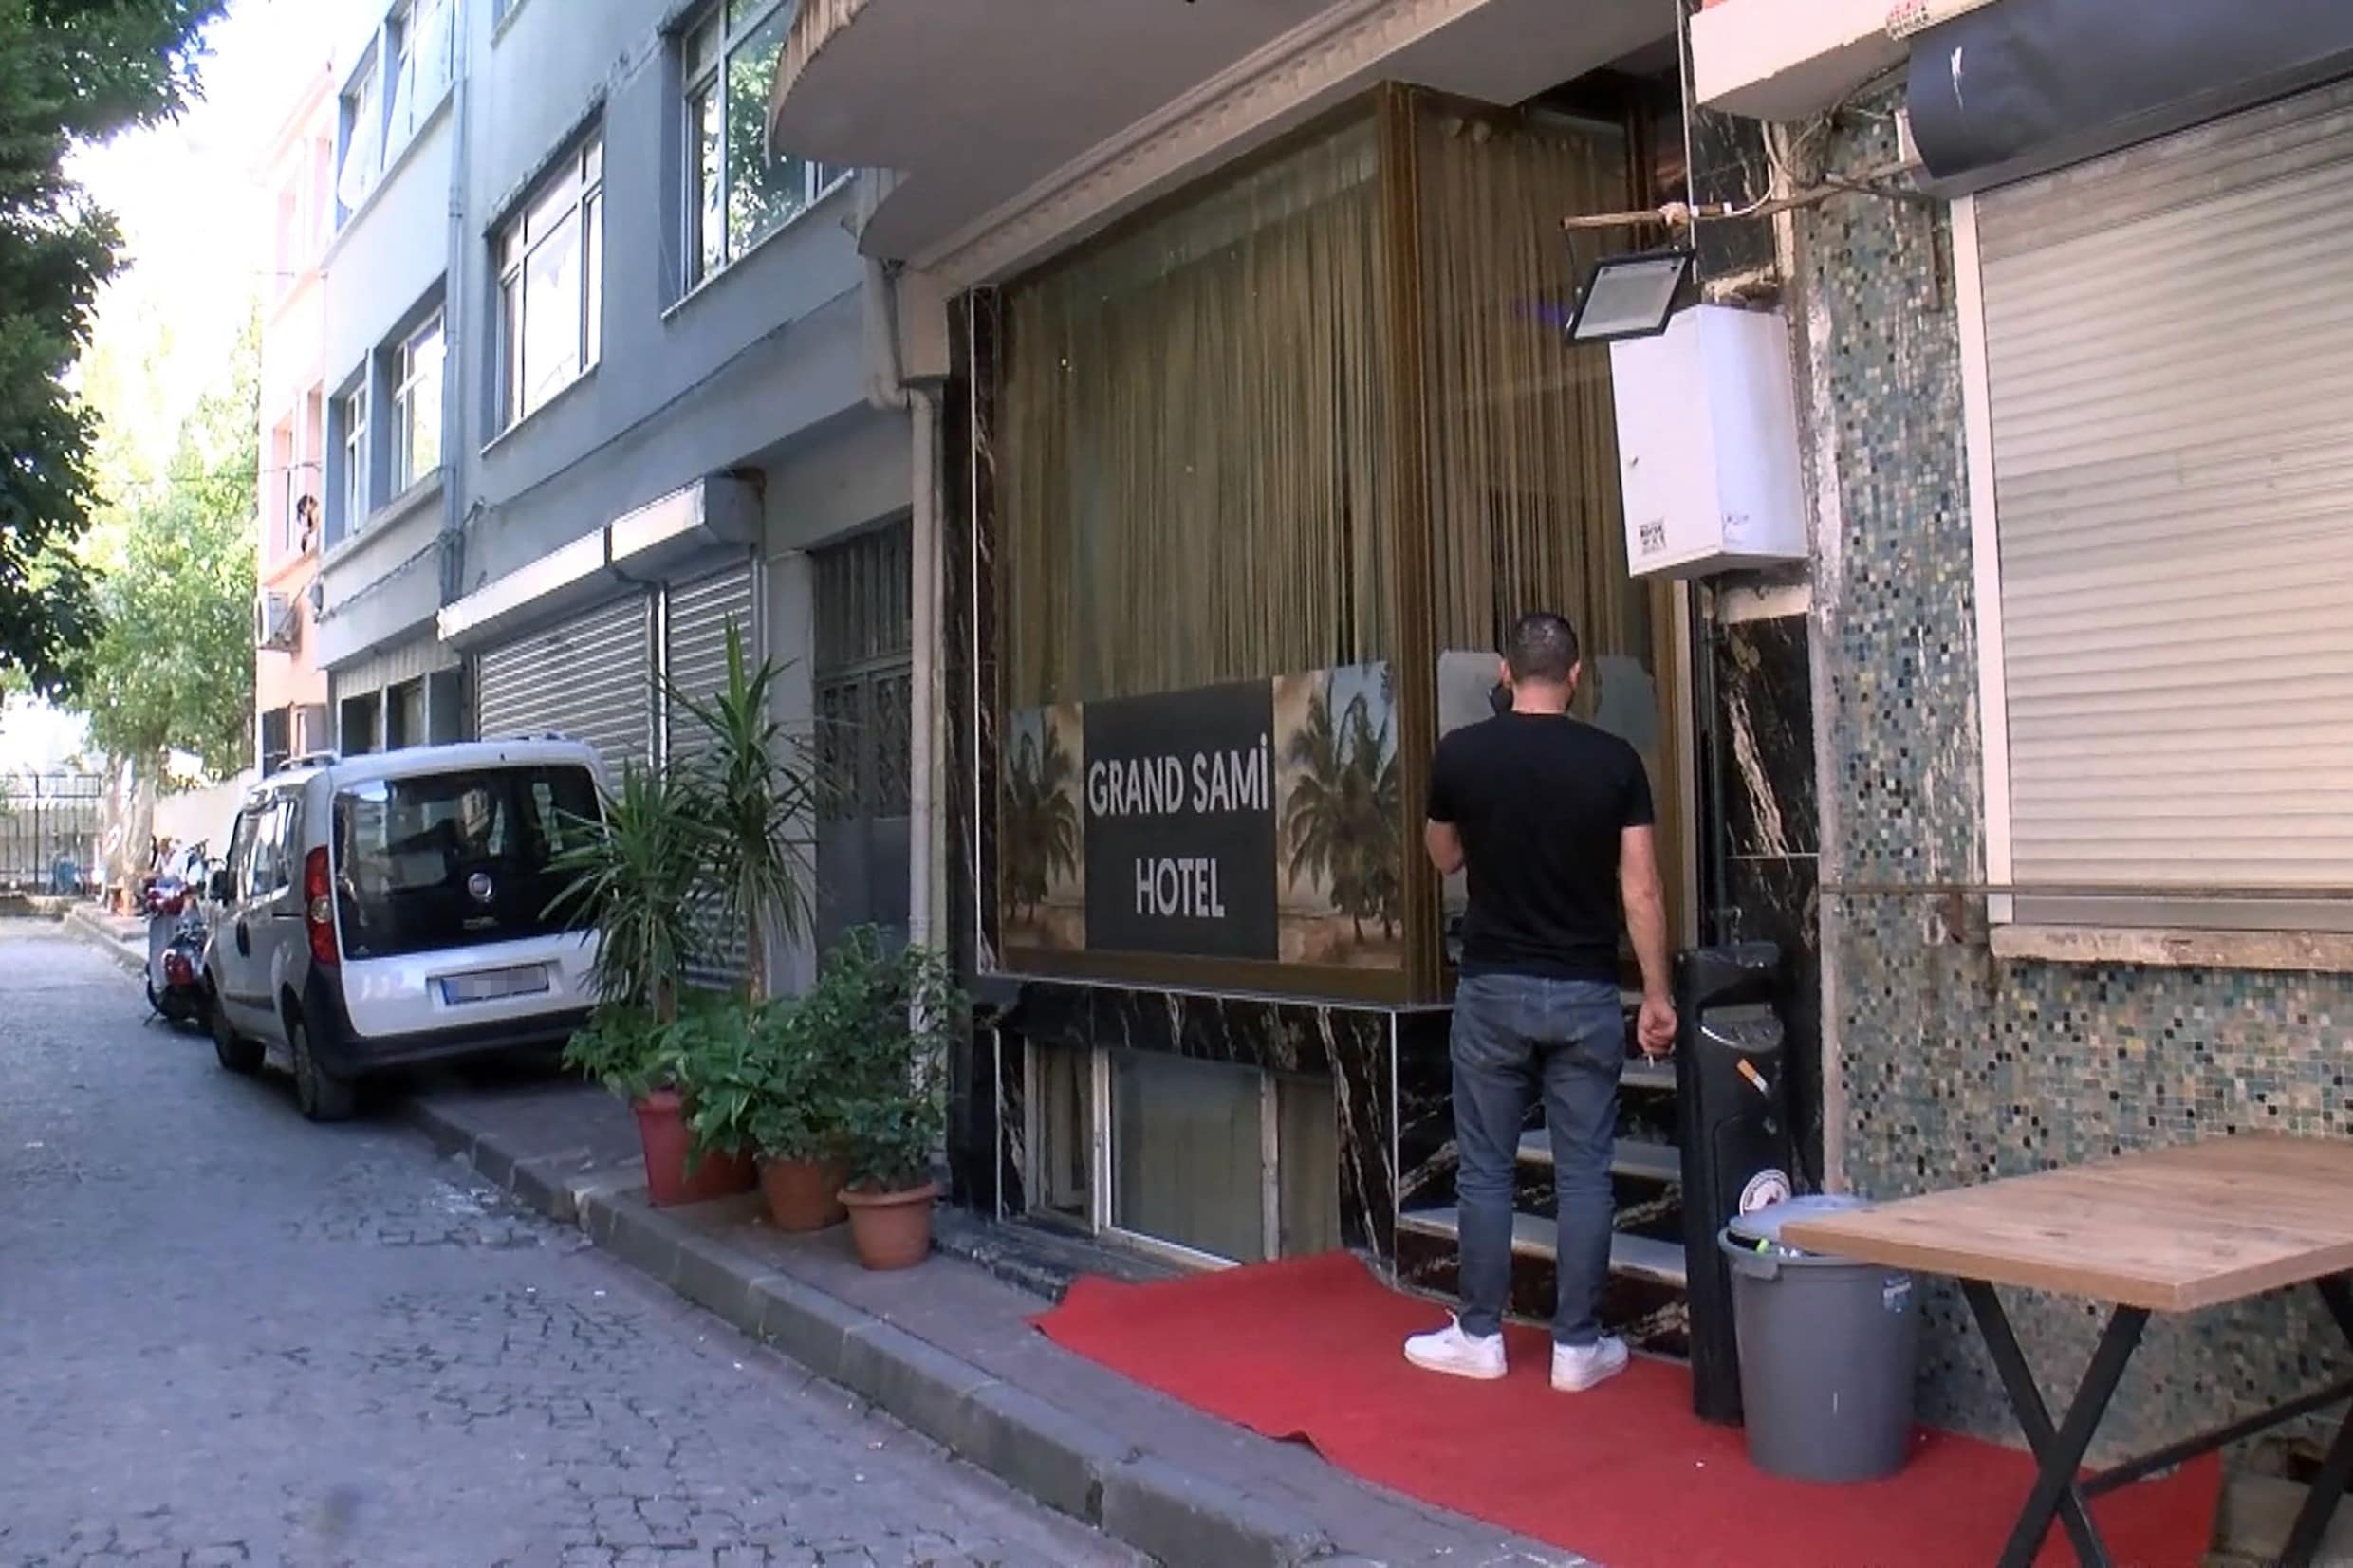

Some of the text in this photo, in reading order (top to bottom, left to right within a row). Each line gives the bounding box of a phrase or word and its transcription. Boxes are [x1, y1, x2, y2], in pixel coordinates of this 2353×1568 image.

[1088, 733, 1269, 816] GRAND SAMİ
[1136, 858, 1225, 918] HOTEL
